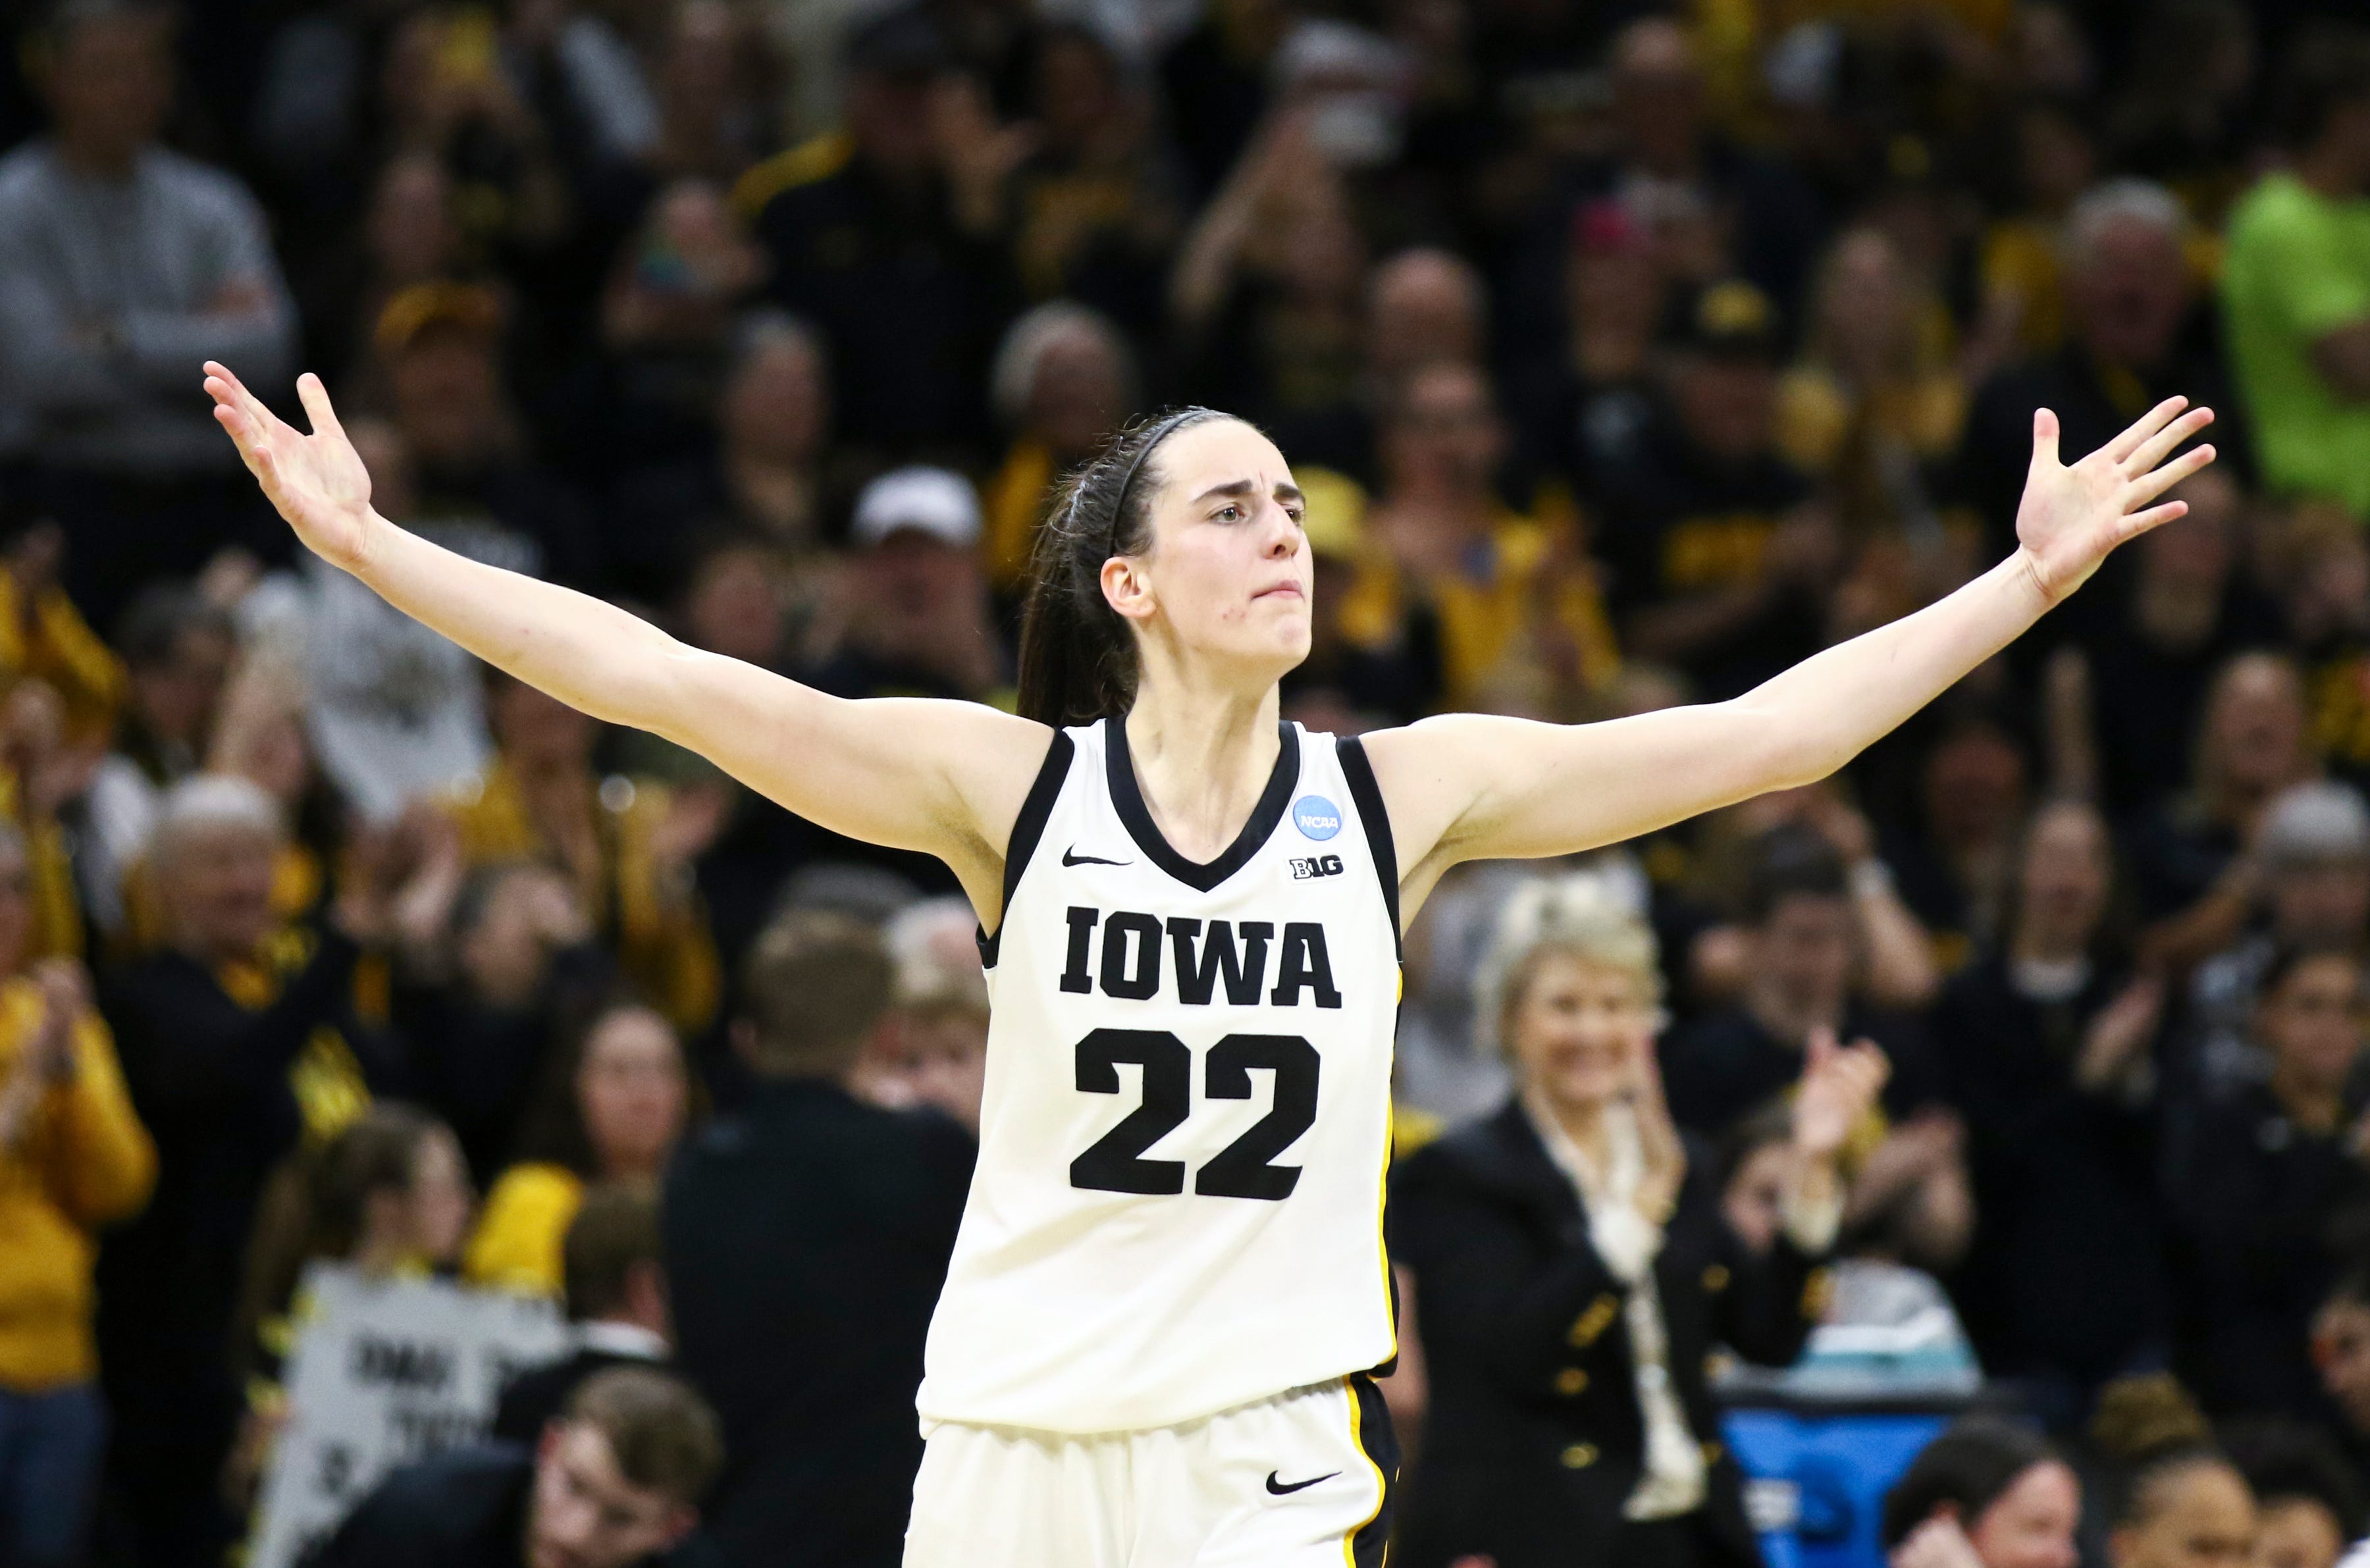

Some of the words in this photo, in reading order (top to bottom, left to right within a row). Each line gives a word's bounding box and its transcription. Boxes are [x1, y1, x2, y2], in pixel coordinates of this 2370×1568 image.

[1301, 816, 1338, 829] NCAA
[1060, 906, 1342, 1008] IOWA
[1070, 1028, 1321, 1200] 22
